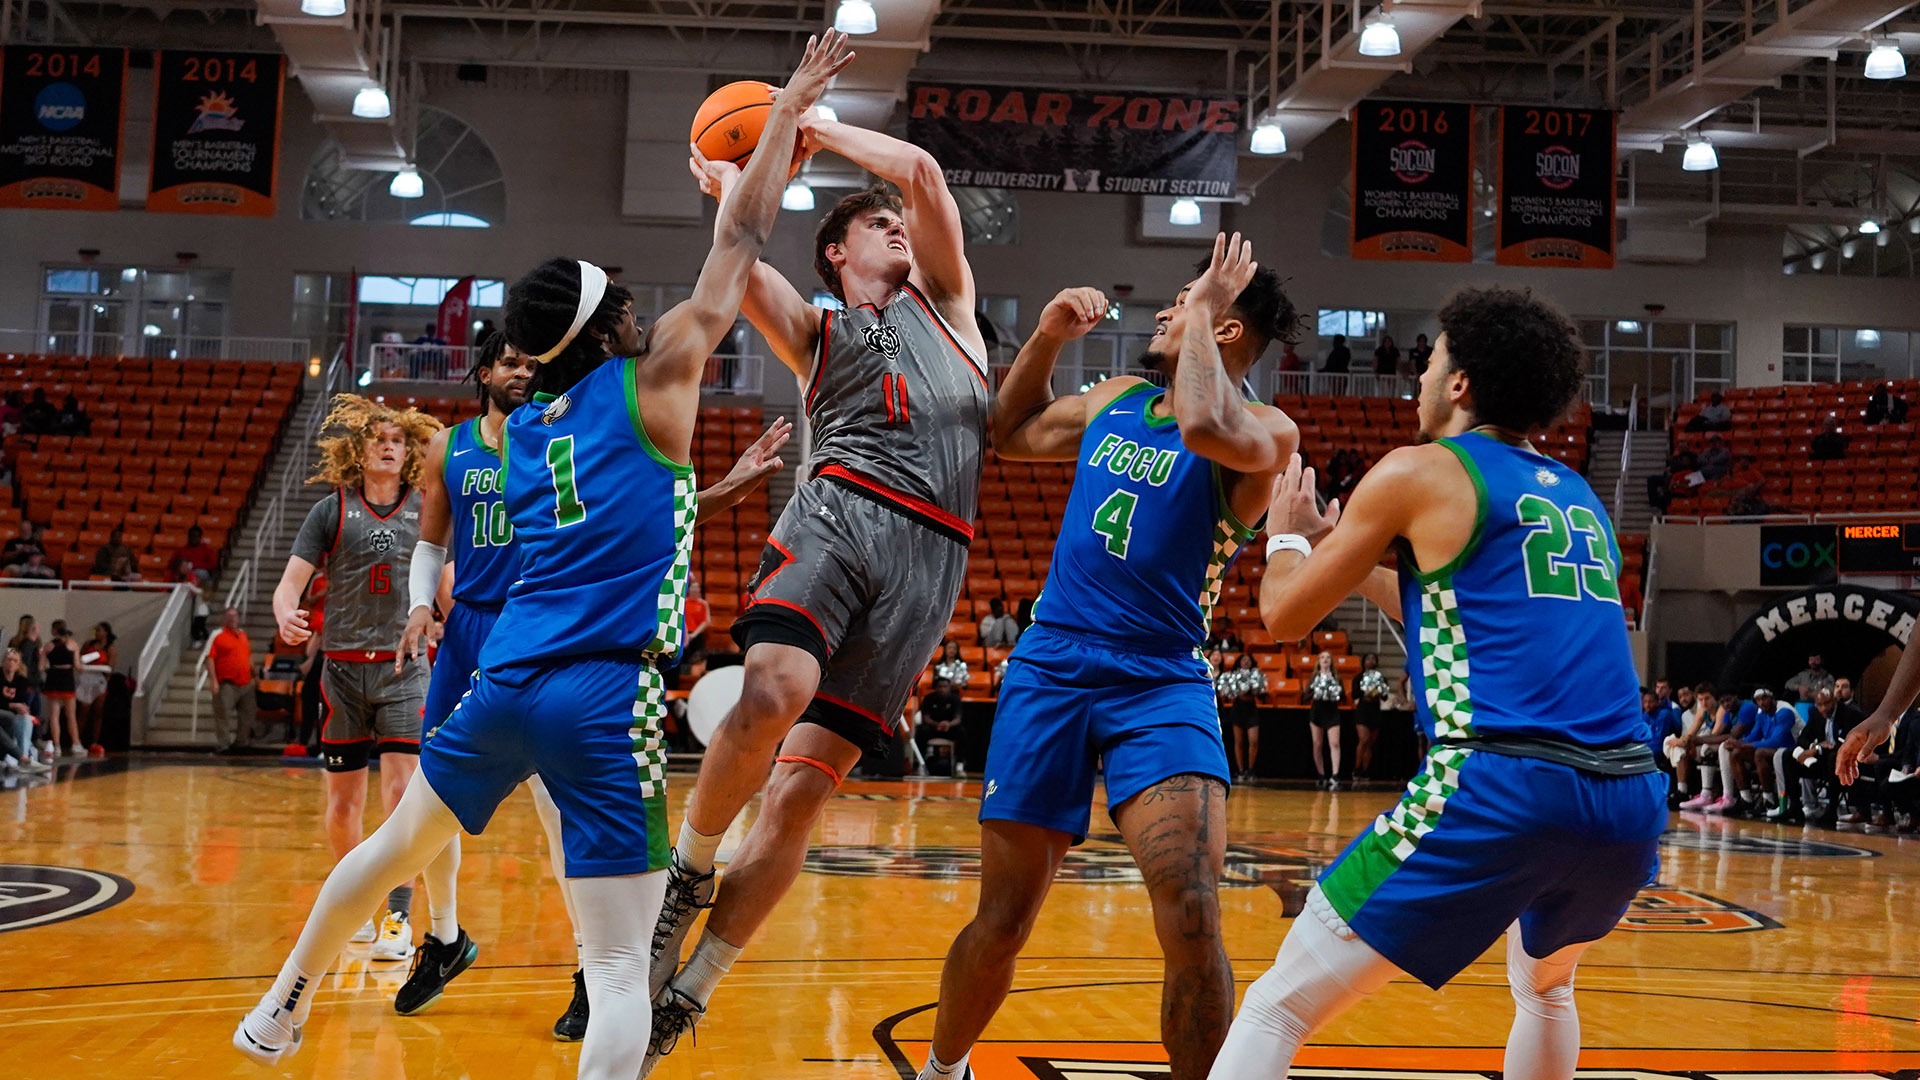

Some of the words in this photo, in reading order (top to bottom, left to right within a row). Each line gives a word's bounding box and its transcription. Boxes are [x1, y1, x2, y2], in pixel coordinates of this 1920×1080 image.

[25, 52, 102, 79] 2014
[182, 56, 258, 85] 2014
[37, 104, 85, 120] NCAA
[910, 86, 1074, 127] ROAR
[1086, 94, 1241, 133] ZONE
[1378, 106, 1449, 134] 2016
[1524, 109, 1593, 137] 2017
[1, 143, 52, 155] MIDWEST
[54, 145, 114, 158] REGIONAL
[18, 135, 47, 145] MEN'S
[49, 135, 101, 147] BASKETBALL
[172, 140, 202, 150] MEN'S
[204, 140, 256, 151] BASKETBALL
[172, 148, 256, 161] TOURNAMENT
[24, 154, 48, 167] 3RD
[49, 154, 95, 168] ROUND
[174, 159, 252, 173] CHAMPIONS
[943, 168, 972, 185] CER
[974, 170, 1062, 190] UNIVERSITY
[1104, 177, 1165, 194] STUDENT
[1169, 179, 1230, 196] SECTION
[1364, 190, 1408, 200] WOMEN'S
[1410, 190, 1459, 202] BASKETBALL
[1364, 199, 1404, 208] SOUTHERN
[1405, 200, 1459, 211] CONFERENCE
[1511, 195, 1553, 205] WOMEN'S
[1555, 196, 1603, 208] BASKETBALL
[1376, 206, 1449, 221] CHAMPIONS
[1510, 204, 1550, 214] SOUTHERN
[1552, 206, 1603, 217] CONFERENCE
[1521, 212, 1592, 228] CHAMPIONS
[881, 372, 910, 424] 11
[1088, 432, 1179, 488] FGCU
[546, 434, 587, 529] 1
[472, 501, 515, 548] 10
[1092, 488, 1139, 560] 4
[1844, 525, 1900, 539] MERCER
[1515, 493, 1622, 606] 23
[1762, 540, 1836, 570] COX
[369, 563, 392, 595] 15
[1756, 592, 1917, 645] MERCER
